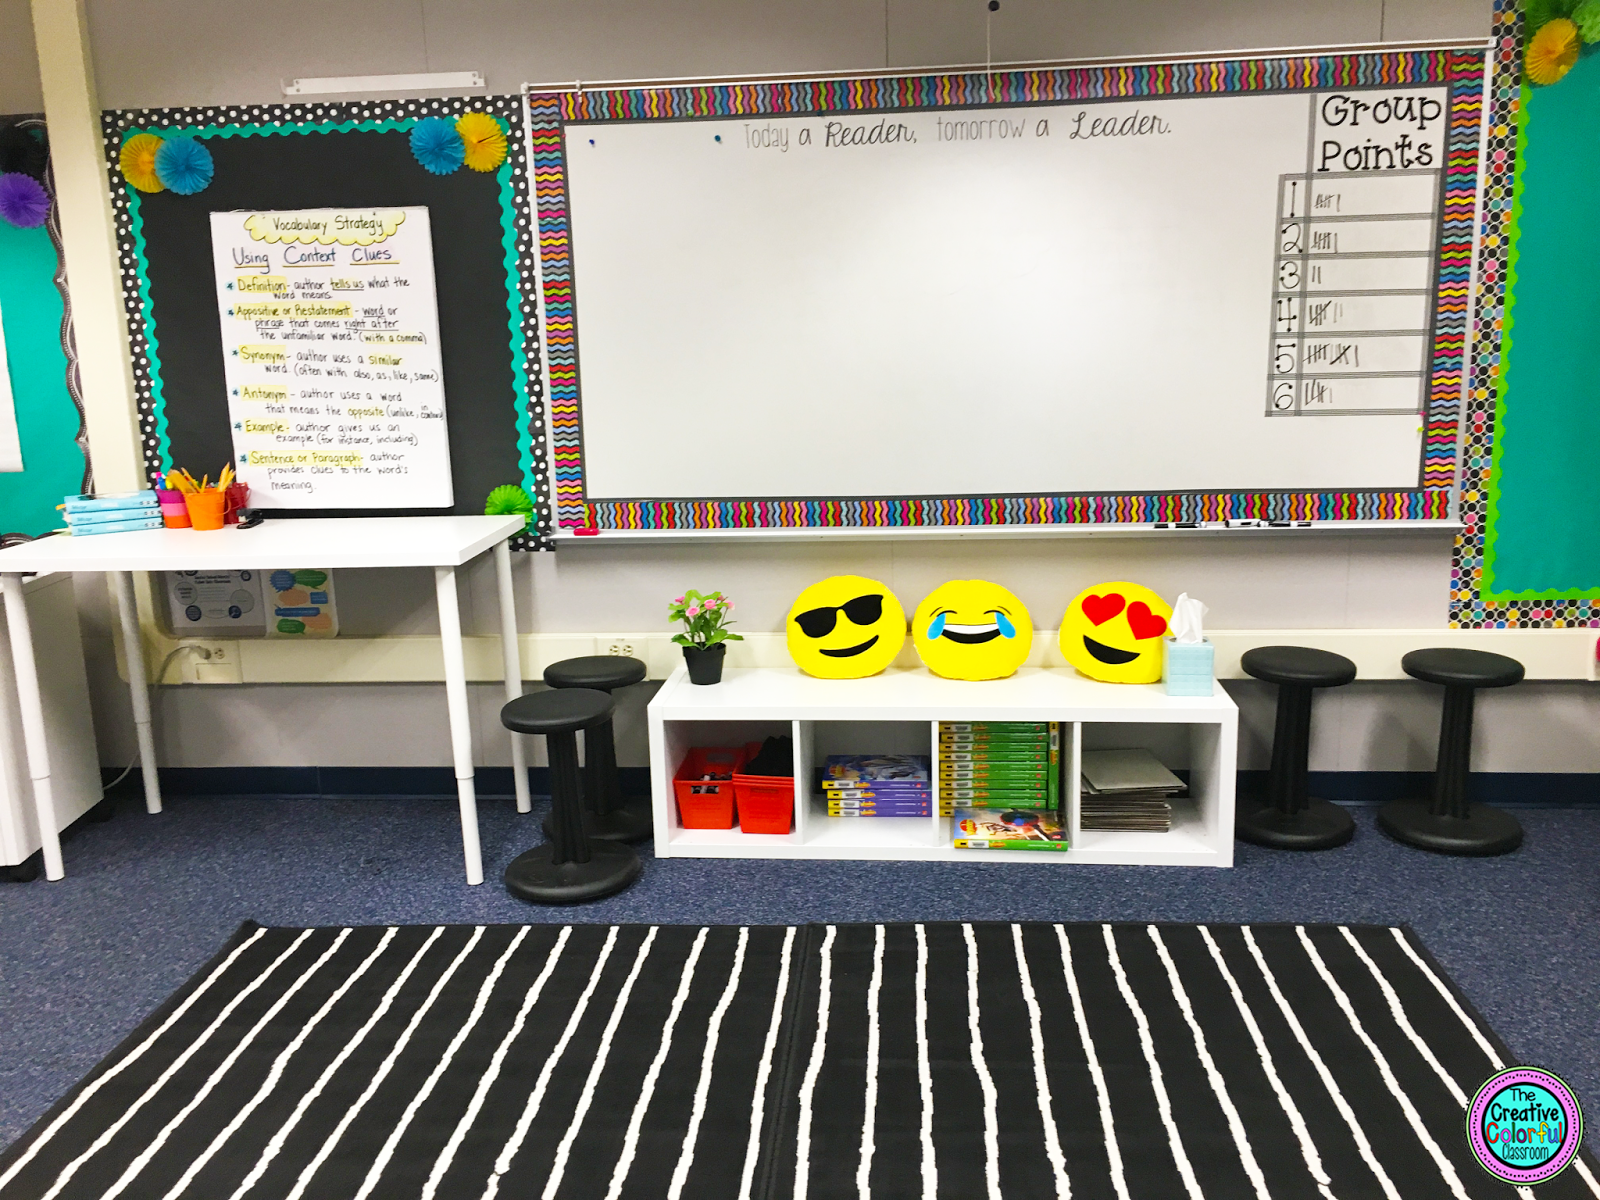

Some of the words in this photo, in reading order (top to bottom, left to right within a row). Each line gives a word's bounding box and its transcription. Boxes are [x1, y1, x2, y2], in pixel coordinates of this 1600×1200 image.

[1322, 95, 1442, 130] Group
[743, 123, 789, 153] Today
[798, 127, 812, 146] a
[825, 118, 918, 148] Reader,
[936, 116, 1026, 142] tomorrow
[1035, 119, 1049, 137] a
[1069, 109, 1172, 140] Leader.
[1317, 134, 1433, 172] Points
[272, 217, 328, 235] Vocabulary
[334, 216, 384, 236] Strategy
[1281, 222, 1303, 253] 2
[232, 247, 270, 274] Using
[283, 245, 336, 264] Context
[352, 248, 392, 261] Clues
[1279, 261, 1301, 289] 3
[294, 280, 325, 290] author
[330, 277, 351, 289] tells
[353, 280, 364, 288] us
[368, 277, 390, 288] what
[394, 276, 410, 287] the
[273, 291, 295, 300] word
[236, 306, 279, 320] Appositive
[295, 305, 351, 315] Restatement
[363, 305, 385, 315] word
[1277, 296, 1297, 333] 4
[254, 319, 284, 333] phrase
[289, 319, 309, 328] that
[345, 319, 366, 334] right
[371, 319, 399, 328] after
[261, 331, 275, 340] the
[281, 331, 325, 340] unfamiliar
[359, 331, 385, 343] (with
[389, 334, 394, 342] a
[396, 331, 427, 345] comma)
[296, 351, 328, 362] author
[332, 354, 351, 364] uses
[357, 356, 365, 364] a
[368, 355, 403, 366] similar
[1275, 343, 1296, 374] 5
[294, 364, 323, 377] (often
[325, 367, 348, 378] with
[353, 370, 374, 381] also,
[376, 372, 392, 382] as,
[392, 369, 414, 384] like,
[414, 369, 439, 383] same)
[242, 387, 287, 401] Antonym
[299, 388, 335, 399] author
[340, 390, 361, 400] uses
[366, 392, 372, 400] a
[380, 391, 402, 402] word
[1273, 382, 1294, 410] 6
[266, 403, 286, 413] that
[289, 406, 320, 415] means
[325, 404, 341, 415] the
[347, 406, 385, 418] opposite
[296, 422, 331, 433] author
[337, 423, 363, 438] gives
[369, 424, 382, 432] us
[387, 423, 400, 432] an
[276, 434, 314, 446] example
[316, 433, 334, 445] (for
[337, 434, 373, 446] instance,
[376, 432, 419, 446] including)
[250, 451, 295, 464] Sentence
[297, 455, 308, 463] or
[370, 453, 405, 462] author
[267, 466, 304, 478] provides
[311, 466, 334, 474] clues
[340, 466, 350, 474] to
[352, 465, 372, 475] the
[377, 465, 409, 474] word's
[270, 481, 317, 493] meaning.
